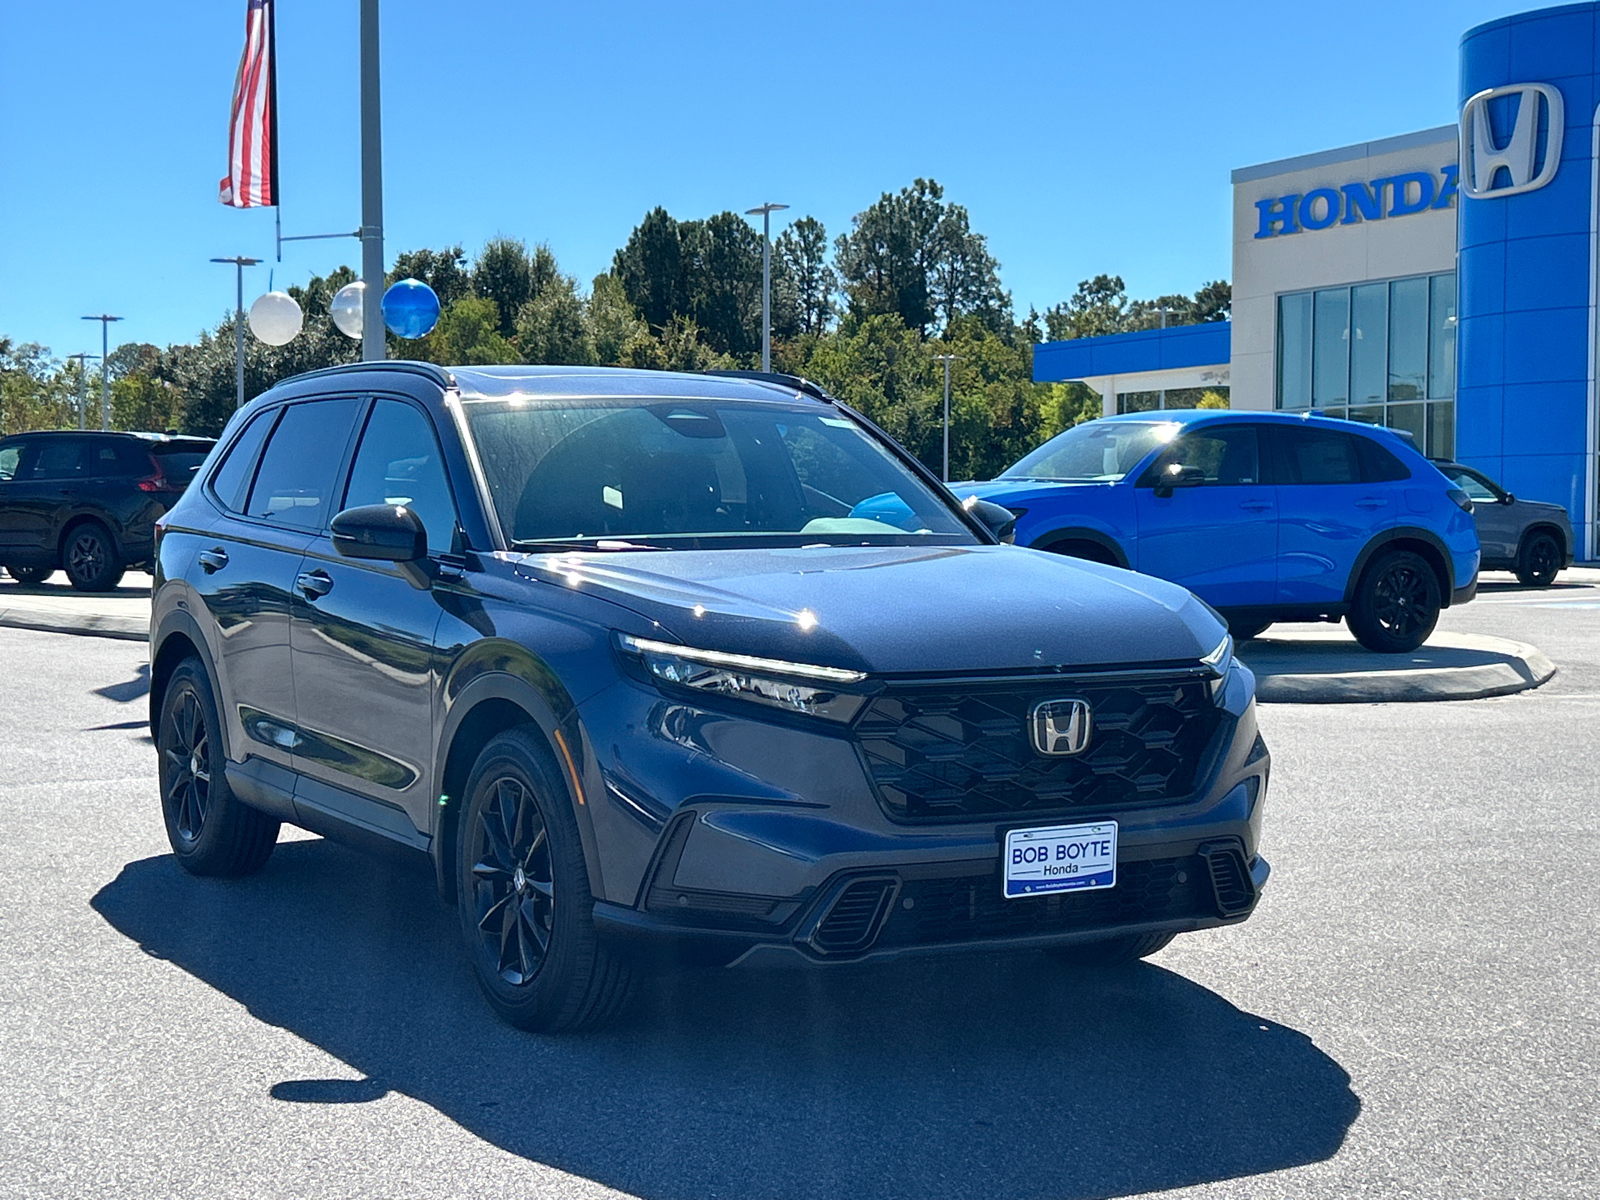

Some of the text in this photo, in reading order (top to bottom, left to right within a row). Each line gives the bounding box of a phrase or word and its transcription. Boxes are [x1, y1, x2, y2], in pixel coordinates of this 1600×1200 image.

[1012, 840, 1111, 864] BOB BOYTE
[1043, 863, 1079, 876] Honda
